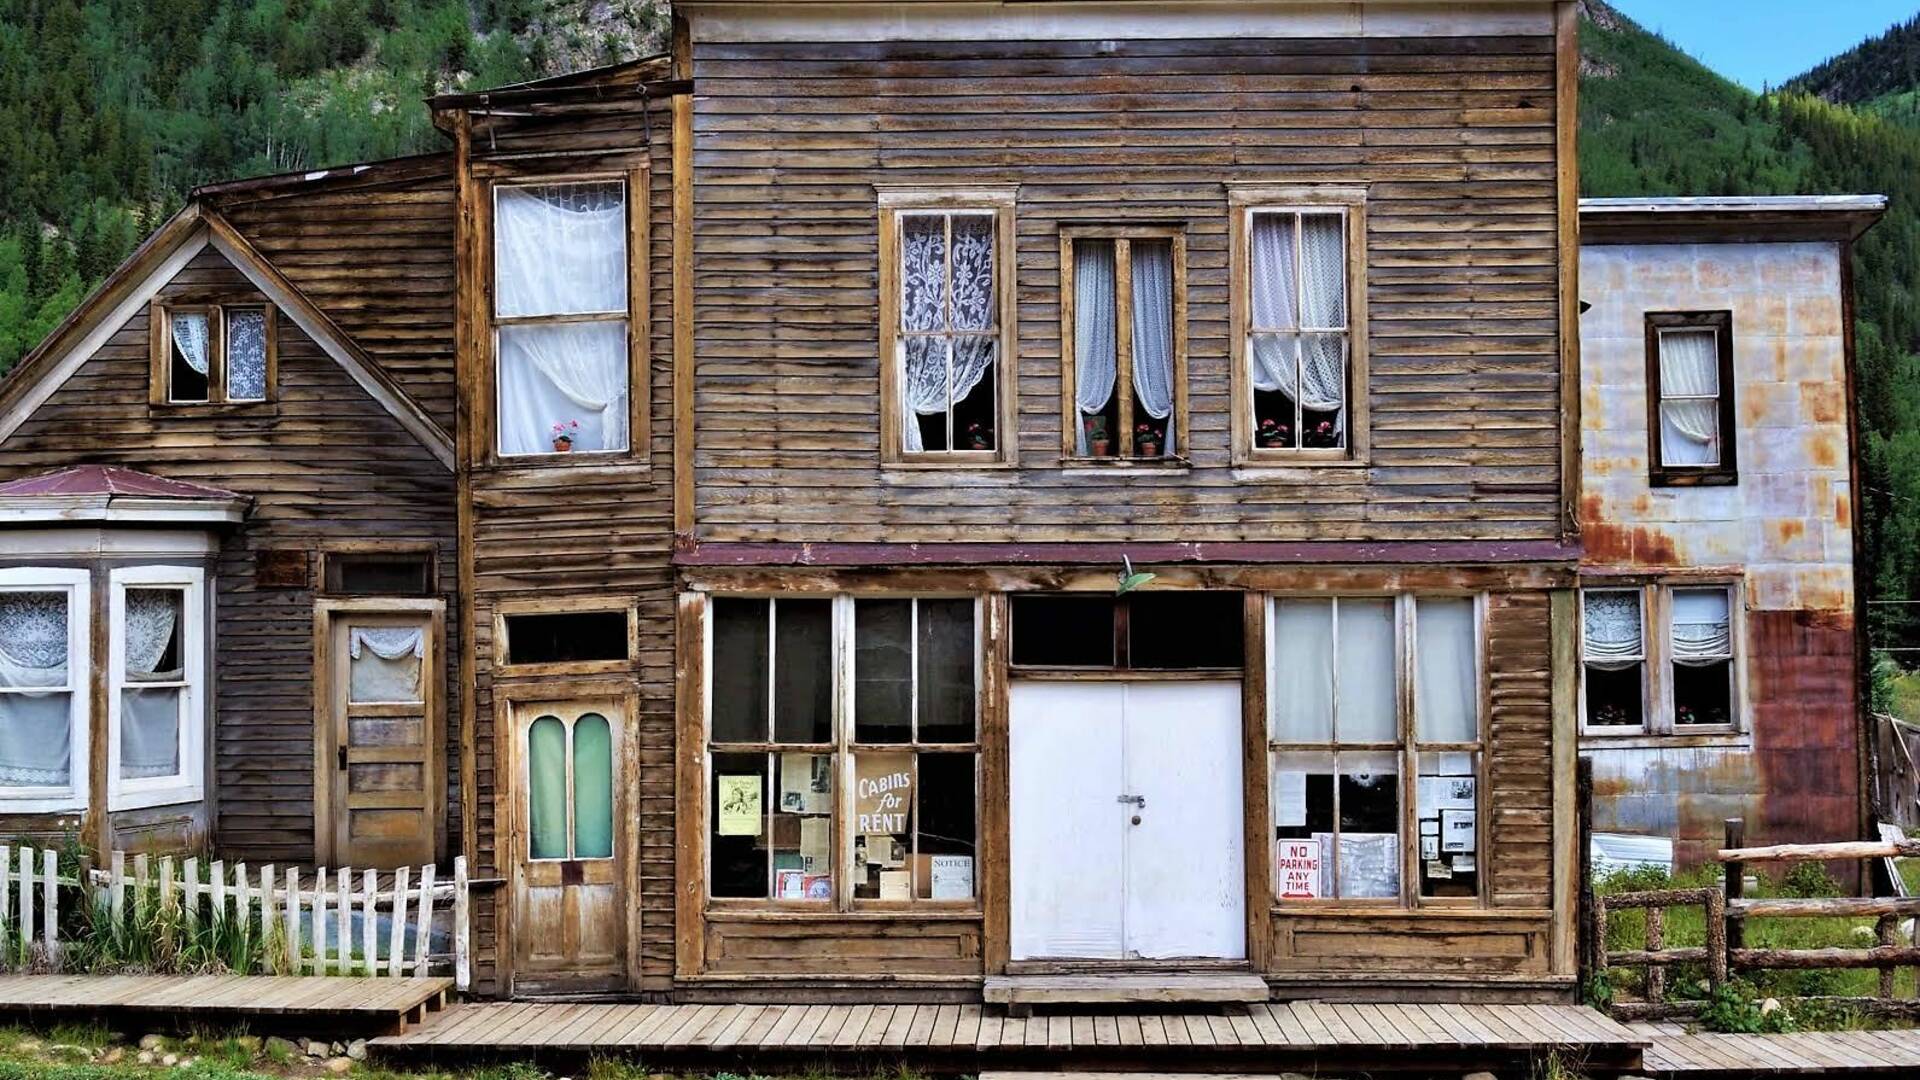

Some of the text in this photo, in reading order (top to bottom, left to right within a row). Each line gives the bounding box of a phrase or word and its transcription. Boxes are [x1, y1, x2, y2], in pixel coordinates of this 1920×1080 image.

[876, 793, 902, 812] for
[859, 814, 904, 832] RENT
[1291, 846, 1307, 857] NO
[1280, 859, 1317, 870] PARKING
[1288, 872, 1308, 880] ANY
[1286, 882, 1309, 890] TIME
